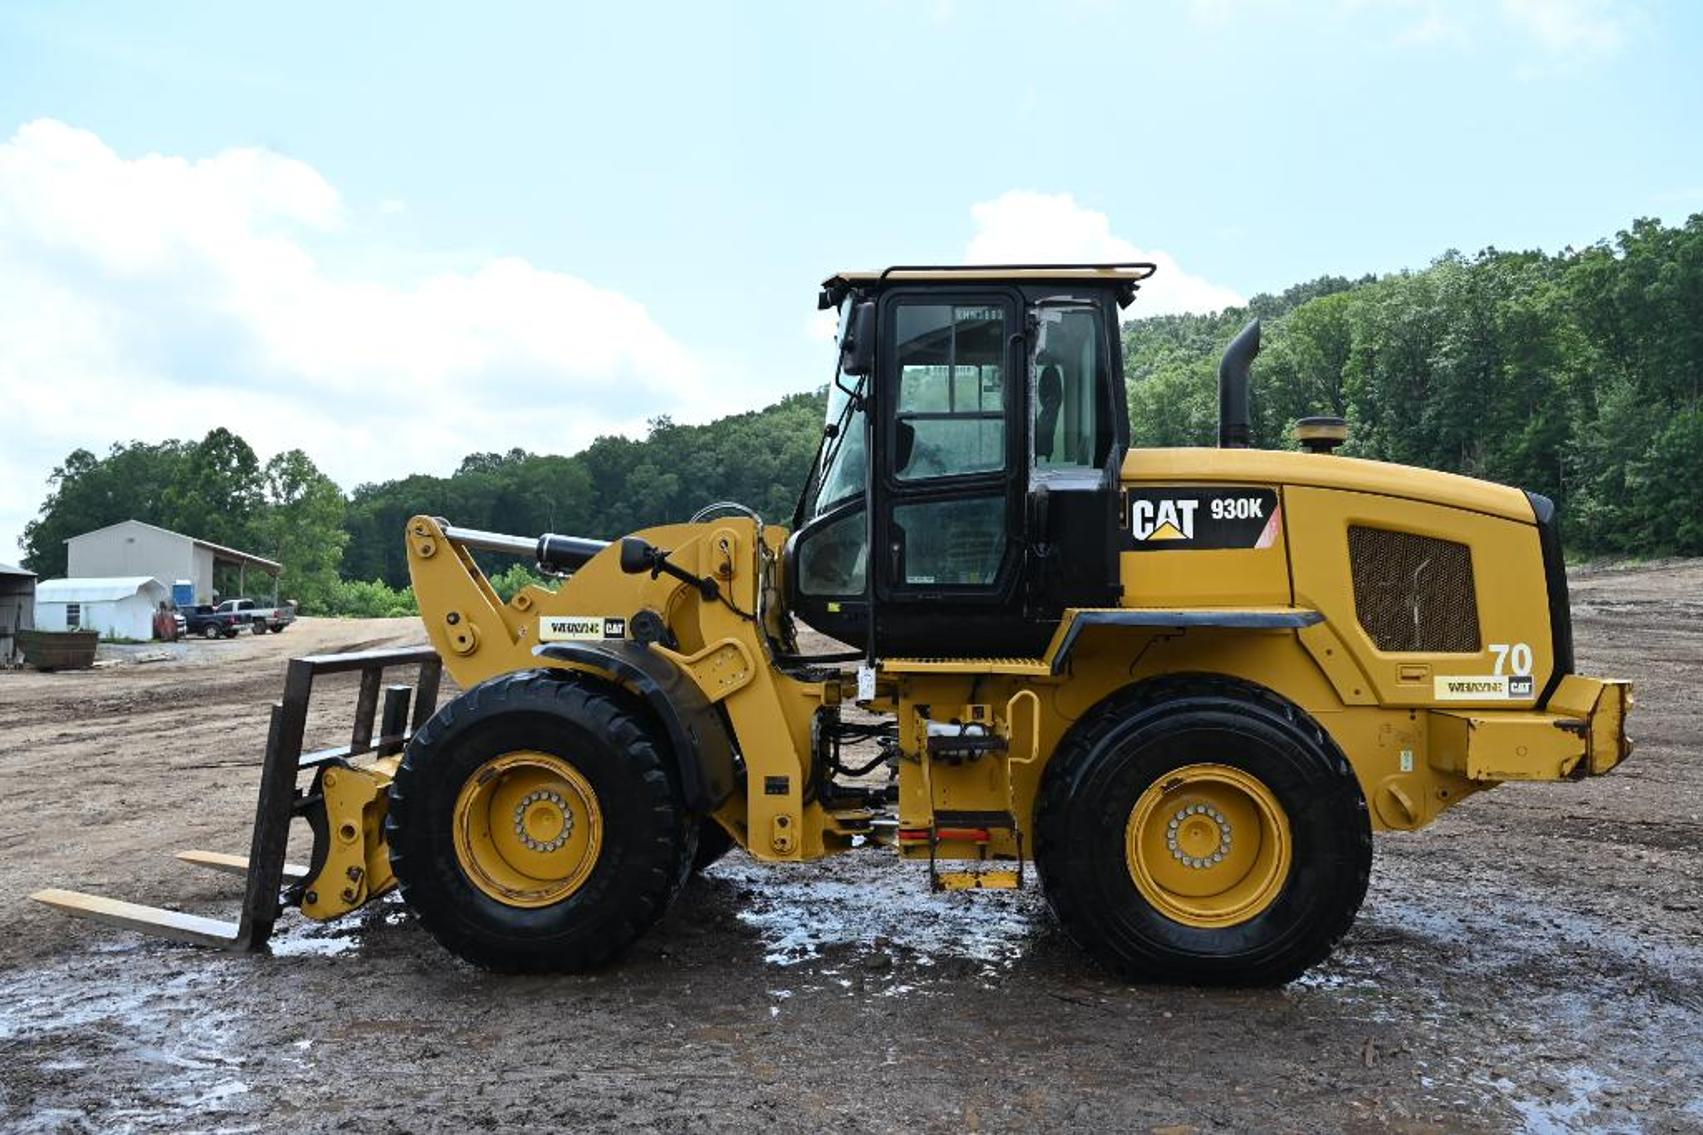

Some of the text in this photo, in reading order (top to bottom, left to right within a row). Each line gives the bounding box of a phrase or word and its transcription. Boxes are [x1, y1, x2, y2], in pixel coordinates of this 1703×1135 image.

[1132, 498, 1264, 541] CAT 930K
[605, 623, 624, 635] CAT
[1488, 642, 1533, 678] 70
[1448, 682, 1532, 694] WHAYNE CAT
